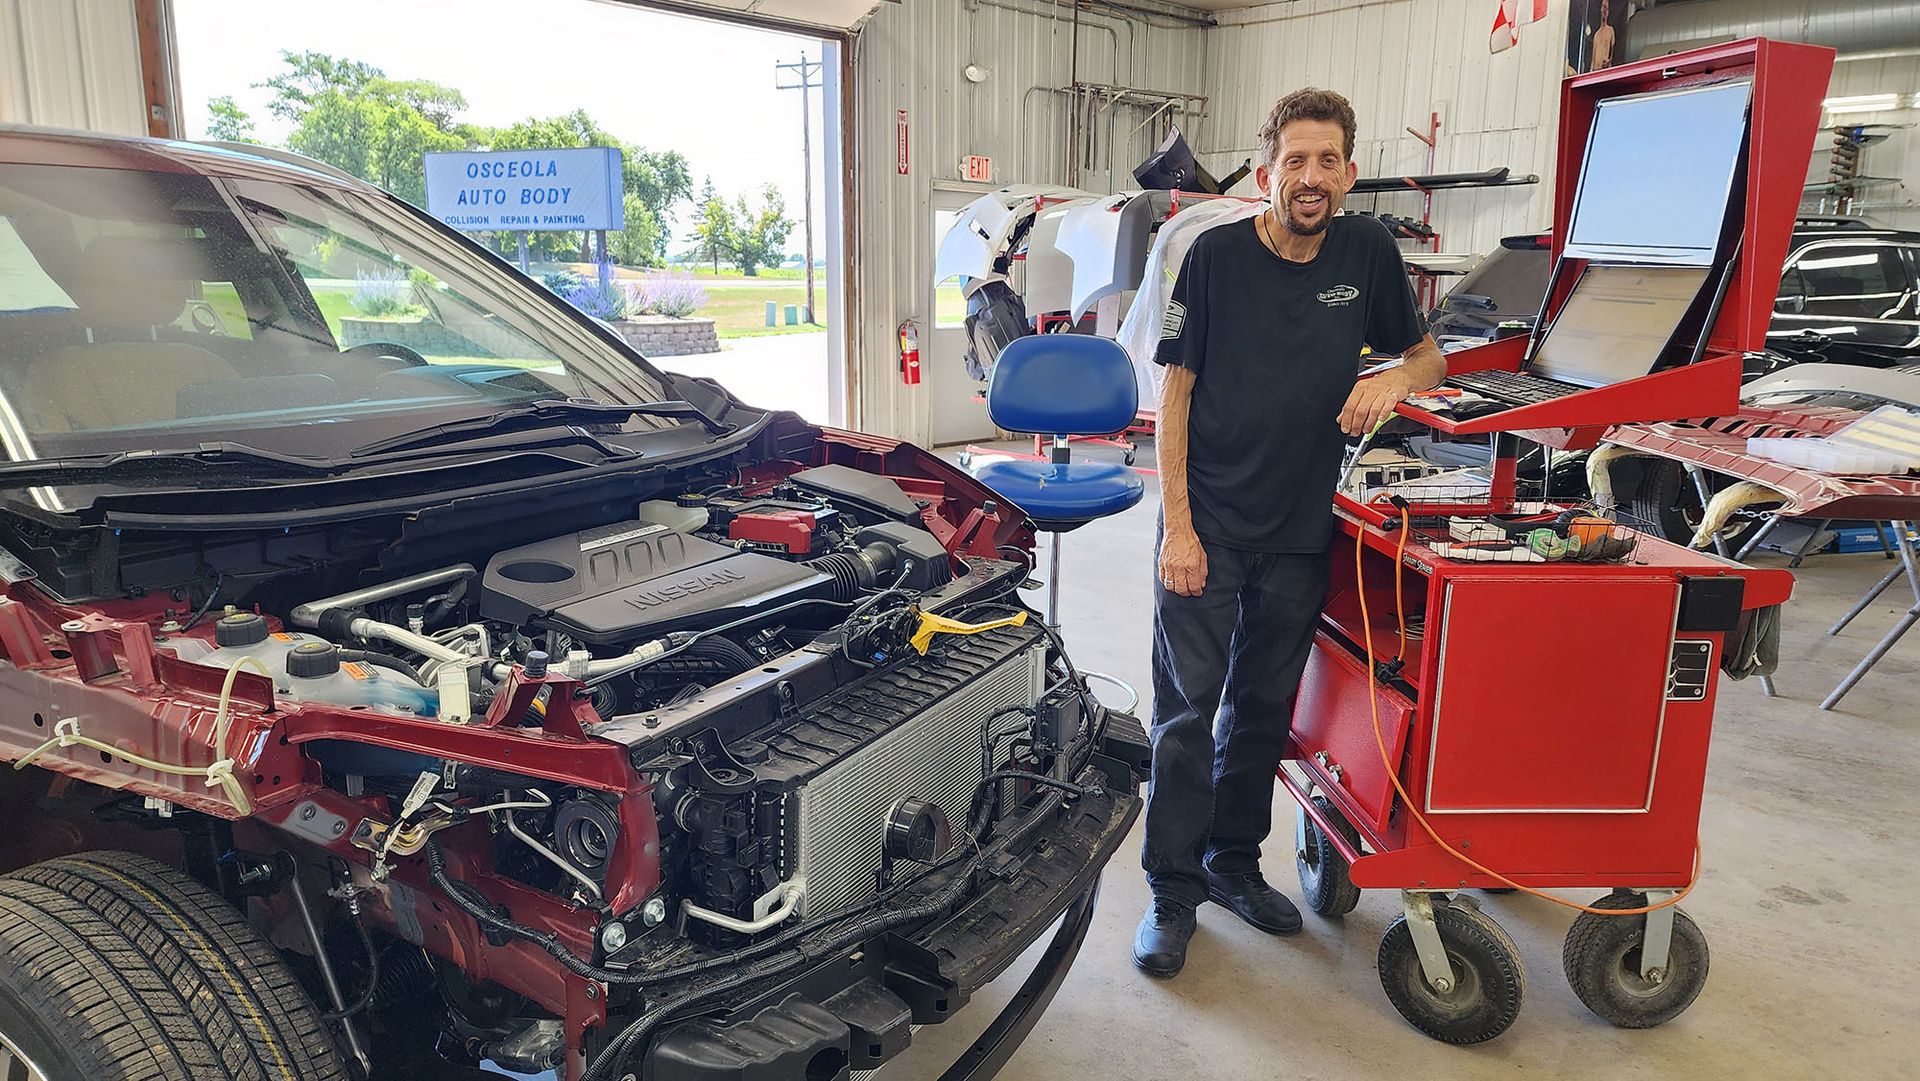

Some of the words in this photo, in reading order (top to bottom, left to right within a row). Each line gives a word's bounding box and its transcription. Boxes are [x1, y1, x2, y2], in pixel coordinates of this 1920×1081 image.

[467, 160, 558, 178] OSCEOLA
[970, 157, 990, 179] EXIT
[457, 188, 507, 206] AUTO
[520, 187, 572, 205] BODY
[445, 215, 490, 225] COLLISION
[500, 215, 531, 224] REPAIR
[533, 216, 539, 224] &
[543, 214, 585, 224] PAINTING
[622, 567, 746, 611] NISSAN
